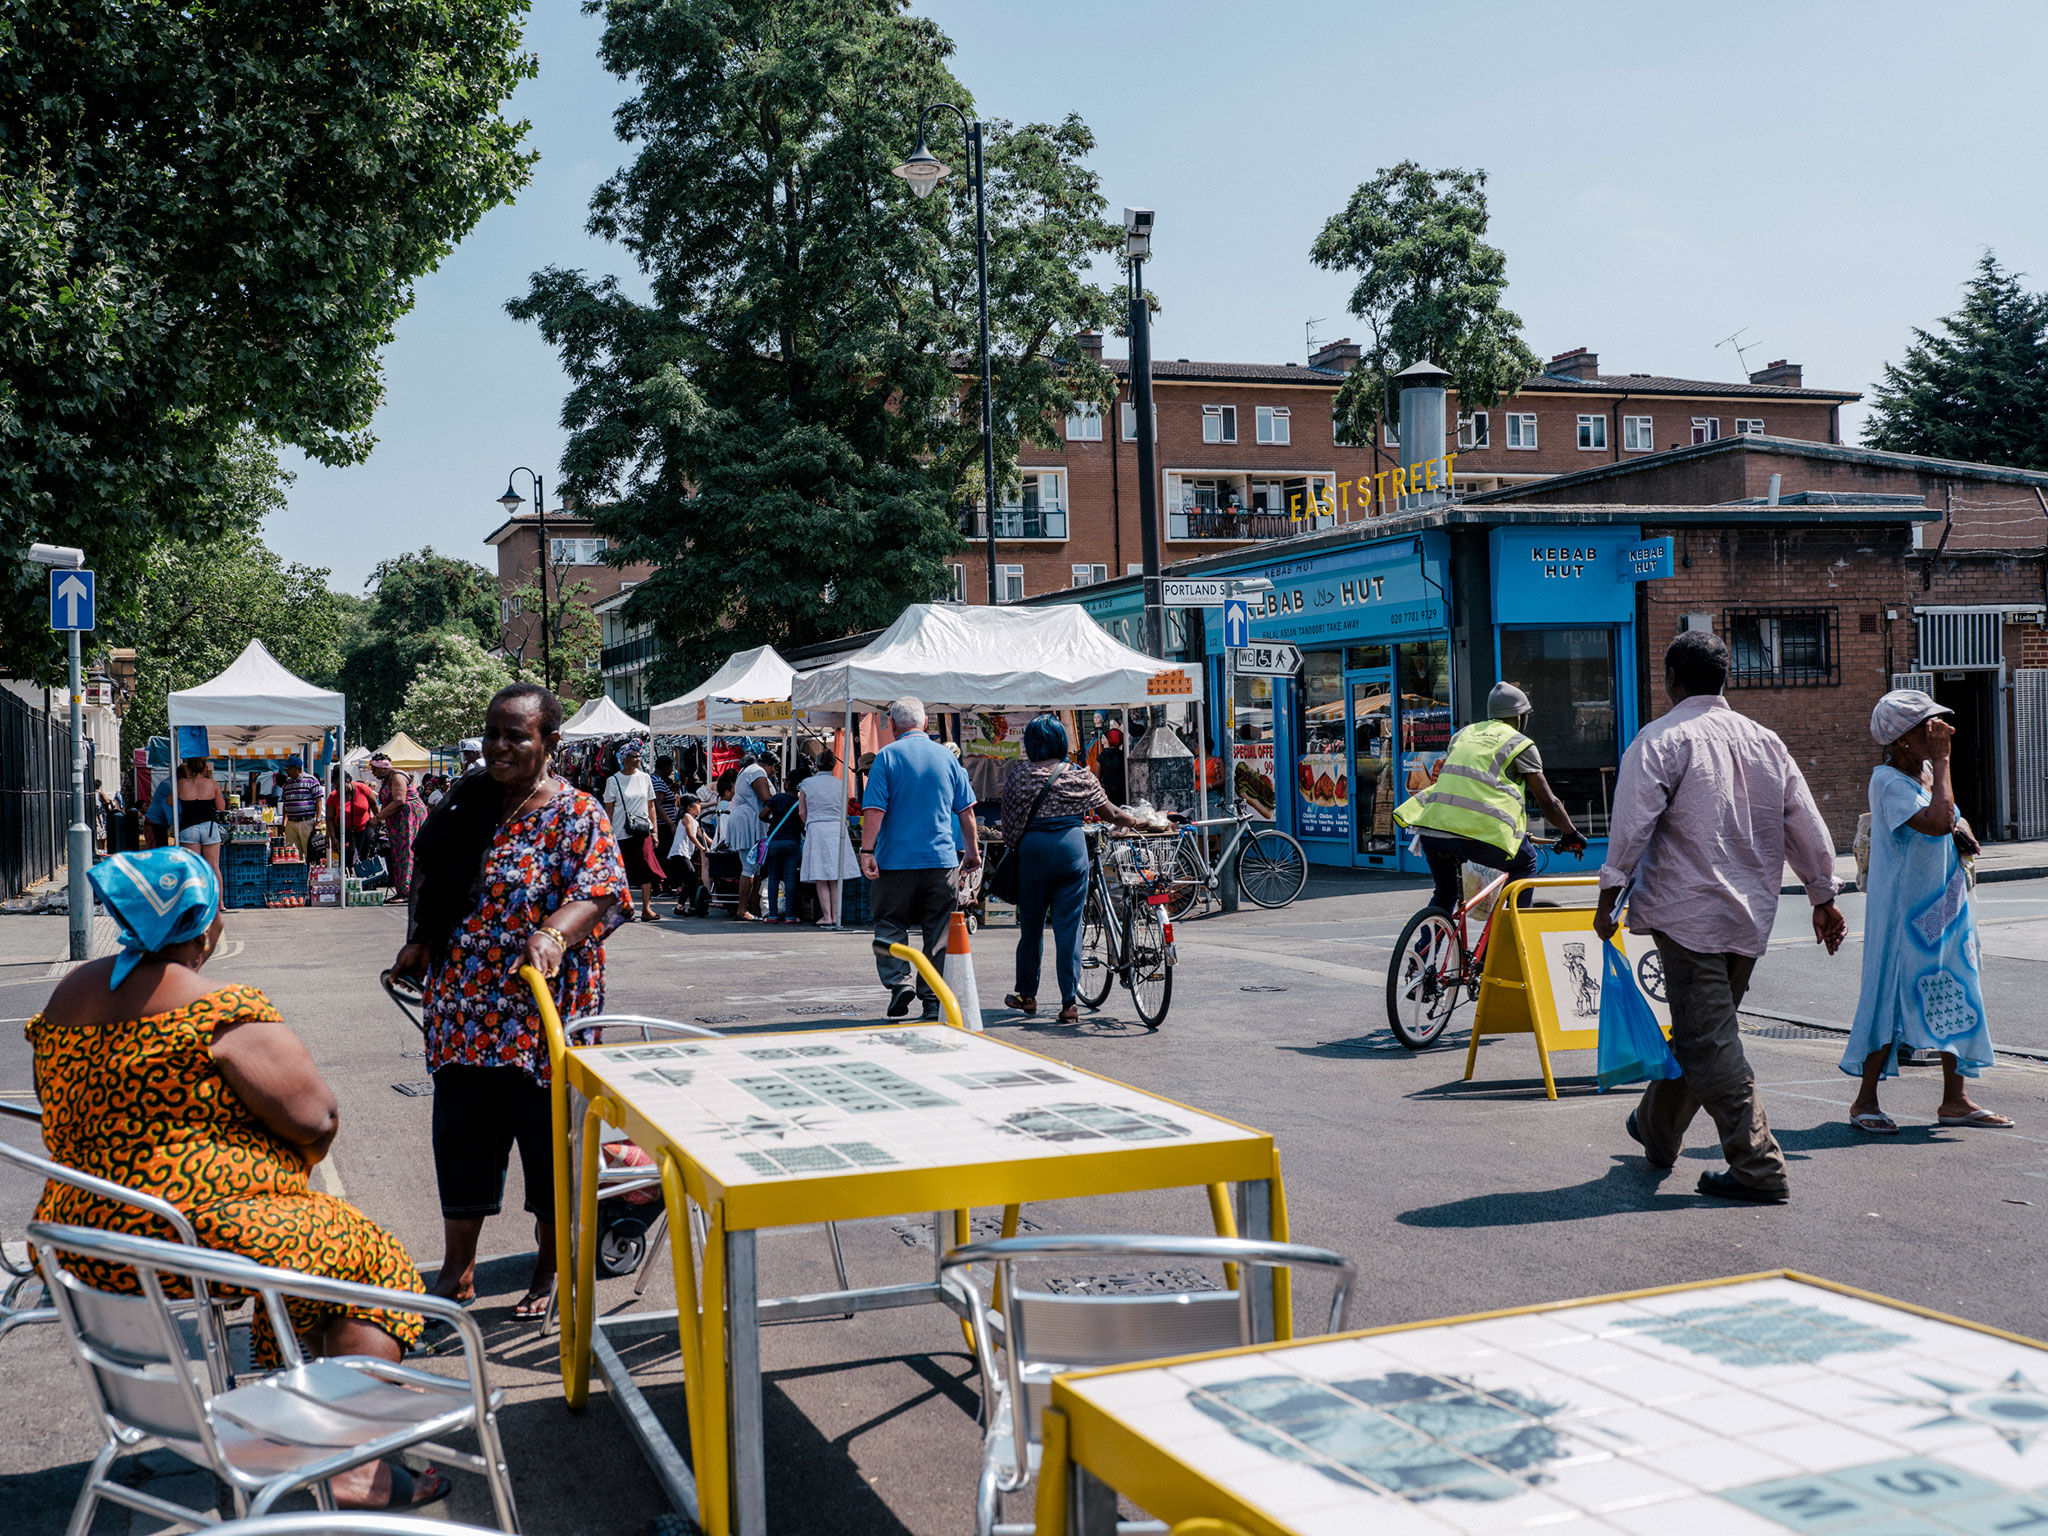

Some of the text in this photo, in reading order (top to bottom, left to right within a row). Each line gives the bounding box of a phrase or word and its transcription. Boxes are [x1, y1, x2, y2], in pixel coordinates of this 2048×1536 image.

[1291, 453, 1458, 522] EAST STREET
[1531, 547, 1597, 562] KEBAB
[1628, 546, 1664, 562] KEBAB
[1264, 561, 1314, 578] KEBAB HUT
[1544, 564, 1585, 578] HUT
[1634, 560, 1657, 574] HUT
[1165, 584, 1217, 596] PORTLAND
[1340, 576, 1385, 607] HUT
[1099, 599, 1113, 609] KIDS
[1390, 613, 1403, 625] 020
[1404, 611, 1419, 622] 7701
[1262, 618, 1360, 640] HALAL ASIAN TANDOORI TAKE AWAY
[1241, 652, 1253, 663] WC
[1148, 678, 1190, 686] STREET
[1148, 686, 1190, 694] MARKET
[753, 707, 769, 718] FRUIT
[776, 705, 789, 716] VEG
[783, 1066, 889, 1110] STREET
[836, 1062, 948, 1107] MARKET
[743, 1077, 815, 1107] EAST
